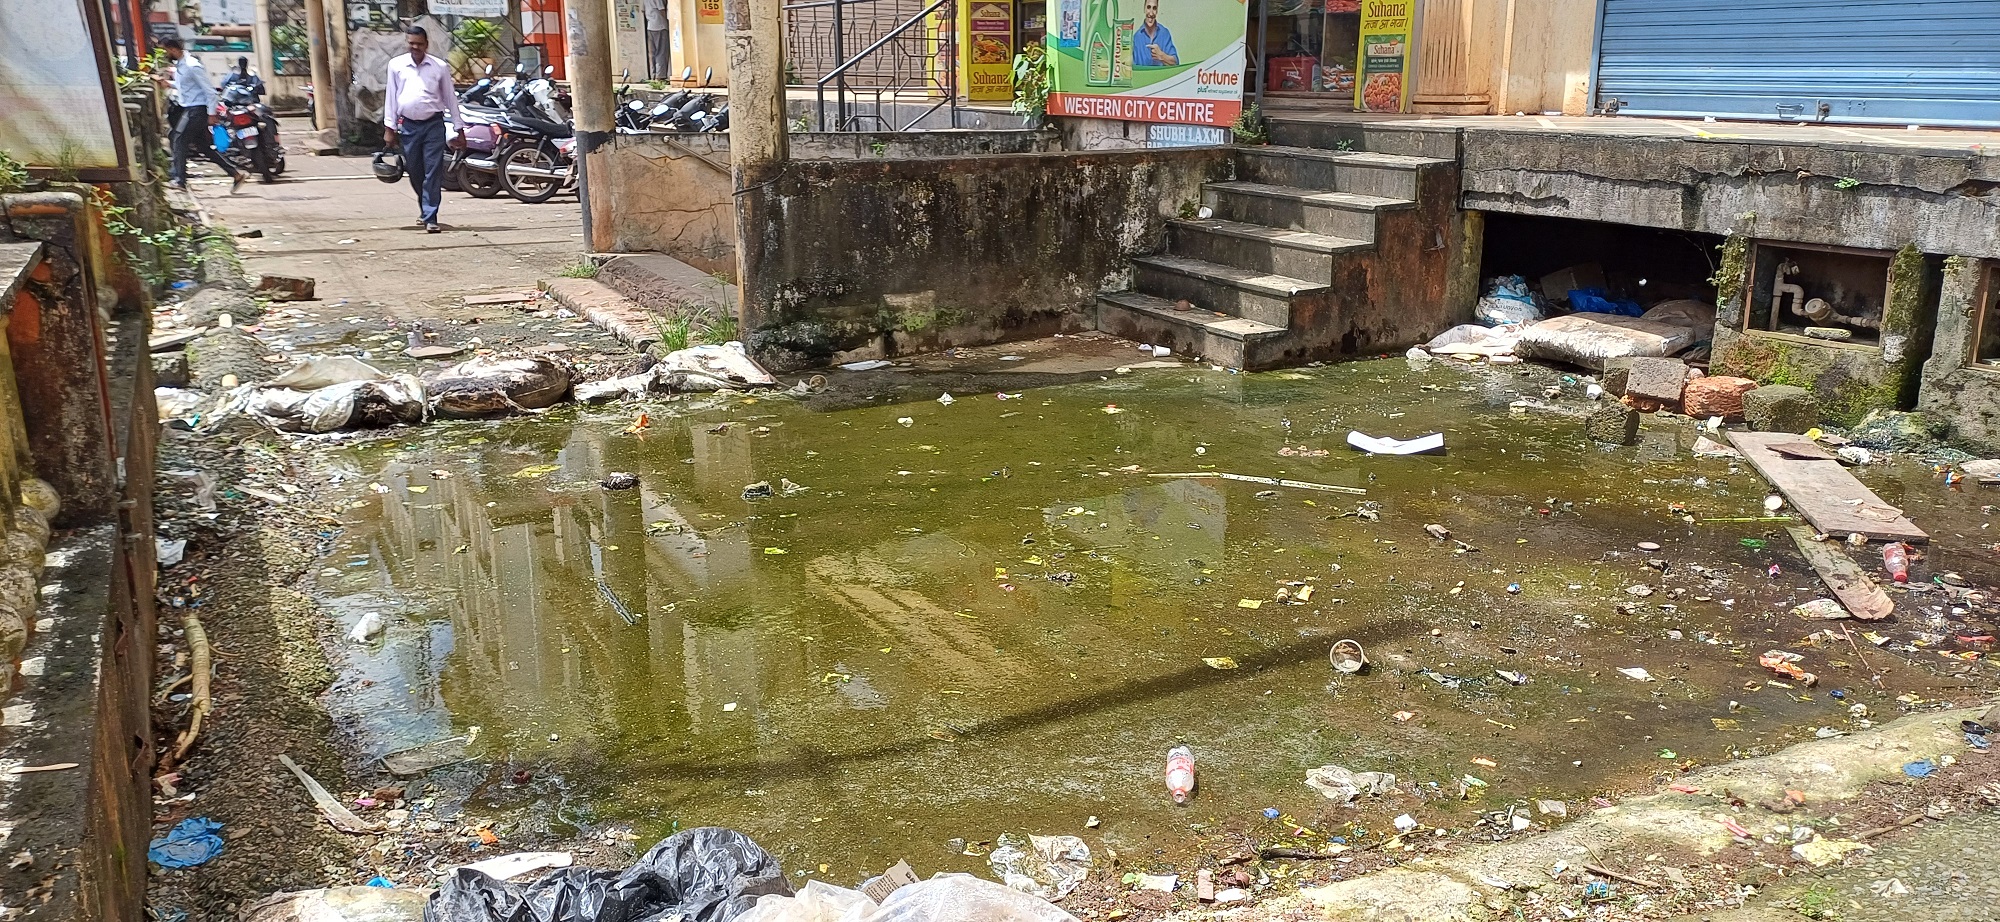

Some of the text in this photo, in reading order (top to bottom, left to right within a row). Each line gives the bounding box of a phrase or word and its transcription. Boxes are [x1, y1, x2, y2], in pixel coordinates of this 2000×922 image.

[1368, 0, 1405, 17] Suhana
[1197, 68, 1238, 85] fortune
[1064, 97, 1214, 122] WESTERN CITY CENTRE
[1150, 125, 1224, 144] SHUBH LAXMI
